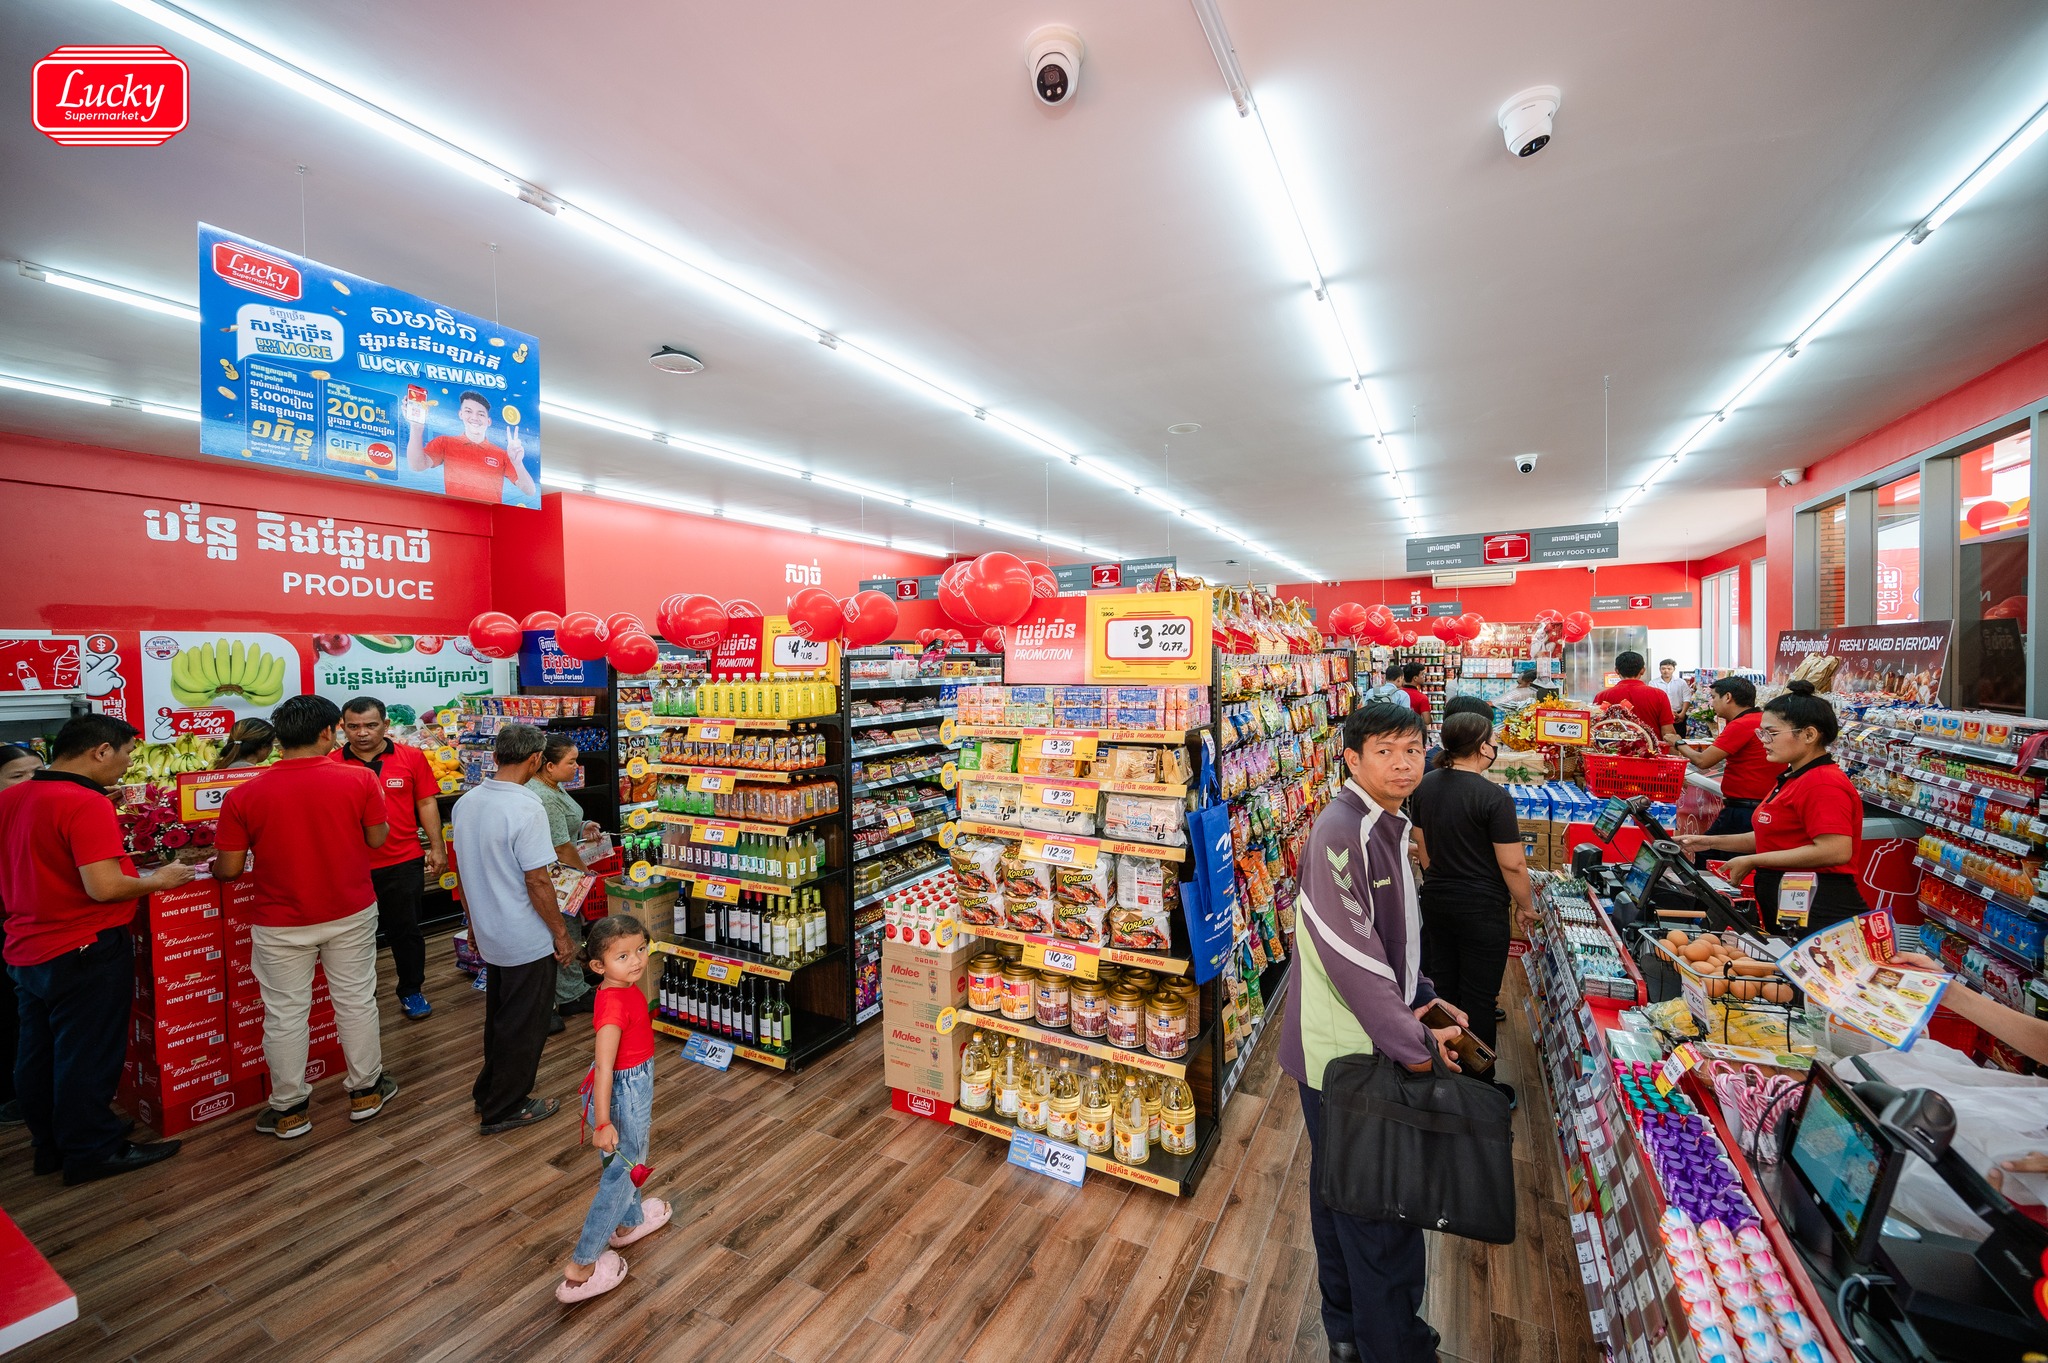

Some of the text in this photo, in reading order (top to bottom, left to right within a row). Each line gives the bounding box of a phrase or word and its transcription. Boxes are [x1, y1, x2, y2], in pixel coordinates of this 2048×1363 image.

[227, 253, 289, 290] Lucky
[232, 270, 276, 288] Supermarket
[371, 306, 477, 342] សមាជិក
[256, 338, 277, 347] BUY
[279, 342, 332, 359] MORE
[251, 371, 284, 384] Get point
[359, 355, 506, 389] LUCKY REWARDS
[359, 396, 375, 405] point
[327, 398, 375, 423] 200
[330, 438, 362, 451] GIFT
[1499, 541, 1509, 556] 1
[1543, 550, 1565, 558] READY
[1426, 557, 1462, 567] DRIED NUTS
[785, 559, 822, 586] សាច់
[1102, 571, 1110, 583] 2
[283, 571, 435, 600] PRODUCE
[904, 585, 911, 595] 3
[1635, 599, 1643, 607] 4
[1014, 617, 1077, 647] ប្រូម៉ូសិន
[692, 635, 716, 645] Lucky
[1158, 641, 1183, 652] $0.77
[1838, 636, 1944, 651] FRESHLY BAKED EVERYDAY
[1013, 648, 1073, 661] PROMOTION
[1489, 647, 1528, 660] SALE
[715, 657, 755, 668] PROMOTION
[553, 674, 564, 682] More
[572, 674, 583, 682] Less
[1138, 784, 1167, 792] PROMOTION
[997, 829, 1020, 837] PROMOTION
[1137, 847, 1167, 855] PROMOTION
[958, 863, 980, 872] KORENO
[1007, 868, 1035, 879] KORENO
[1063, 874, 1093, 884] KORENO
[160, 889, 212, 903] Budweiser
[233, 895, 249, 905] KING
[963, 896, 988, 908] KORENO
[161, 903, 212, 918] KING OF BEERS
[1011, 901, 1037, 912] KORENO
[1059, 906, 1088, 918] KORENO
[1121, 917, 1154, 932] KORENO
[163, 932, 214, 947] Budweiser
[235, 937, 251, 946] KING
[995, 931, 1020, 941] PROMOTION
[164, 945, 215, 962] KING OF BEERS
[1136, 957, 1166, 966] PROMOTION
[890, 964, 920, 978] Malee
[165, 975, 216, 991] Budweiser
[237, 977, 254, 988] KING
[166, 987, 216, 1005] KING OF BEERS
[166, 1016, 217, 1035] Budweiser
[238, 1016, 263, 1028] KING OF
[996, 1023, 1020, 1033] PROMOTION
[167, 1030, 217, 1049] KING OF BEERS
[892, 1029, 922, 1044] Malee
[1063, 1039, 1089, 1050] PROMOTION
[171, 1056, 222, 1078] Budweiser
[241, 1058, 258, 1068] KING
[1137, 1056, 1166, 1070] PROMOTION
[173, 1070, 222, 1092] KING OF BEERS
[198, 1096, 229, 1115] Lucky
[911, 1095, 932, 1110] Lucky
[1131, 1169, 1159, 1185] PROMOTION
